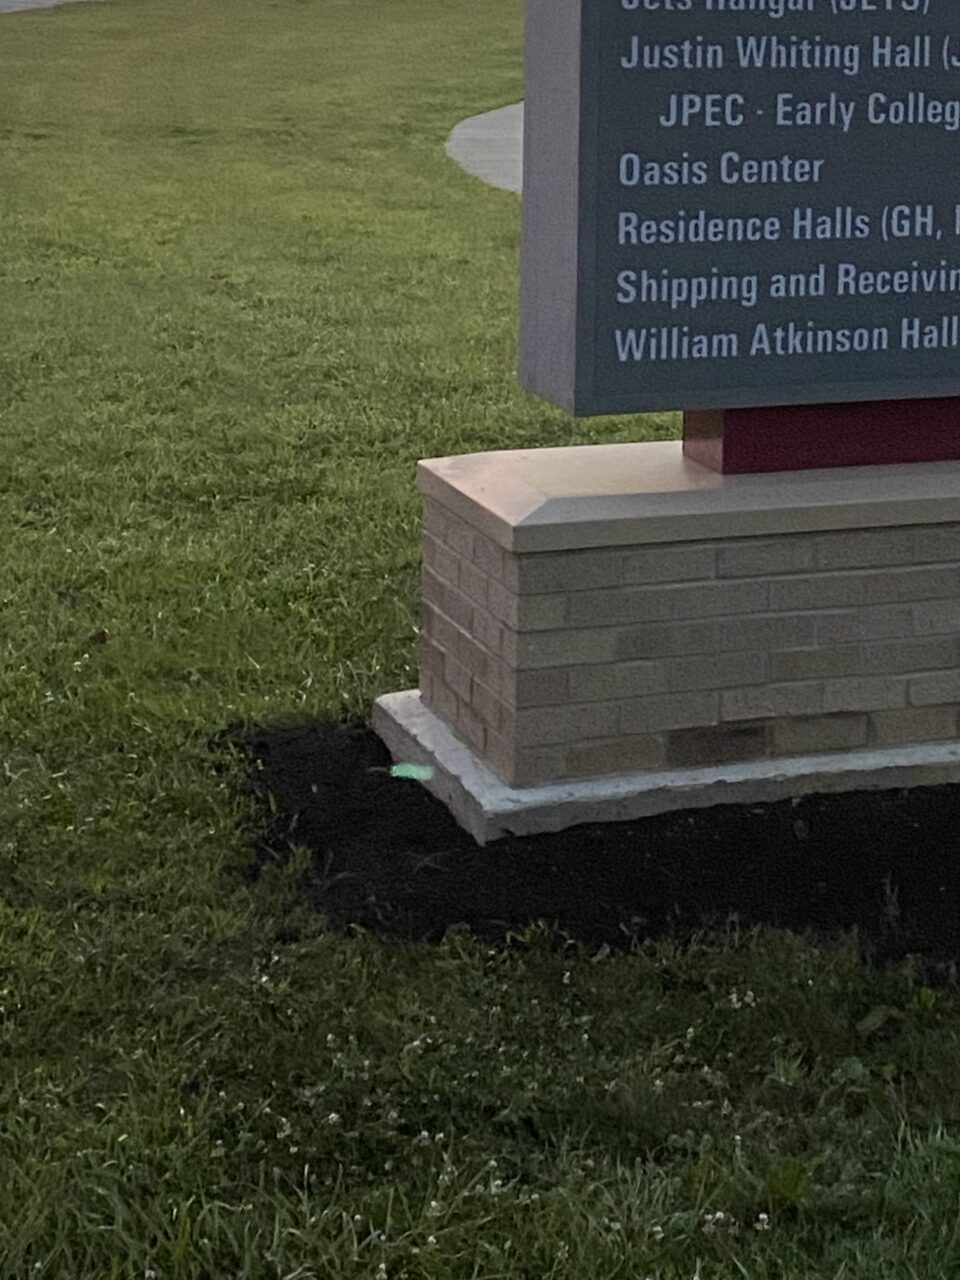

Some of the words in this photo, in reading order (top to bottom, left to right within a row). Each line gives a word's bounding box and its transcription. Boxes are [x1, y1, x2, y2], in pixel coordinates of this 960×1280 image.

[620, 35, 723, 69] Justin
[736, 35, 860, 76] Whiting
[872, 35, 930, 68] Hall
[659, 93, 744, 127] JPEC
[776, 92, 855, 133] Early
[619, 151, 708, 186] Oasis
[720, 151, 825, 184] Center
[618, 209, 781, 245] Residence
[793, 206, 870, 240] Halls
[881, 204, 942, 242] (GH,
[616, 267, 758, 310] Shipping
[769, 263, 825, 298] and
[615, 326, 738, 362] William
[749, 321, 888, 356] Atkinson
[901, 315, 959, 349] Hall
